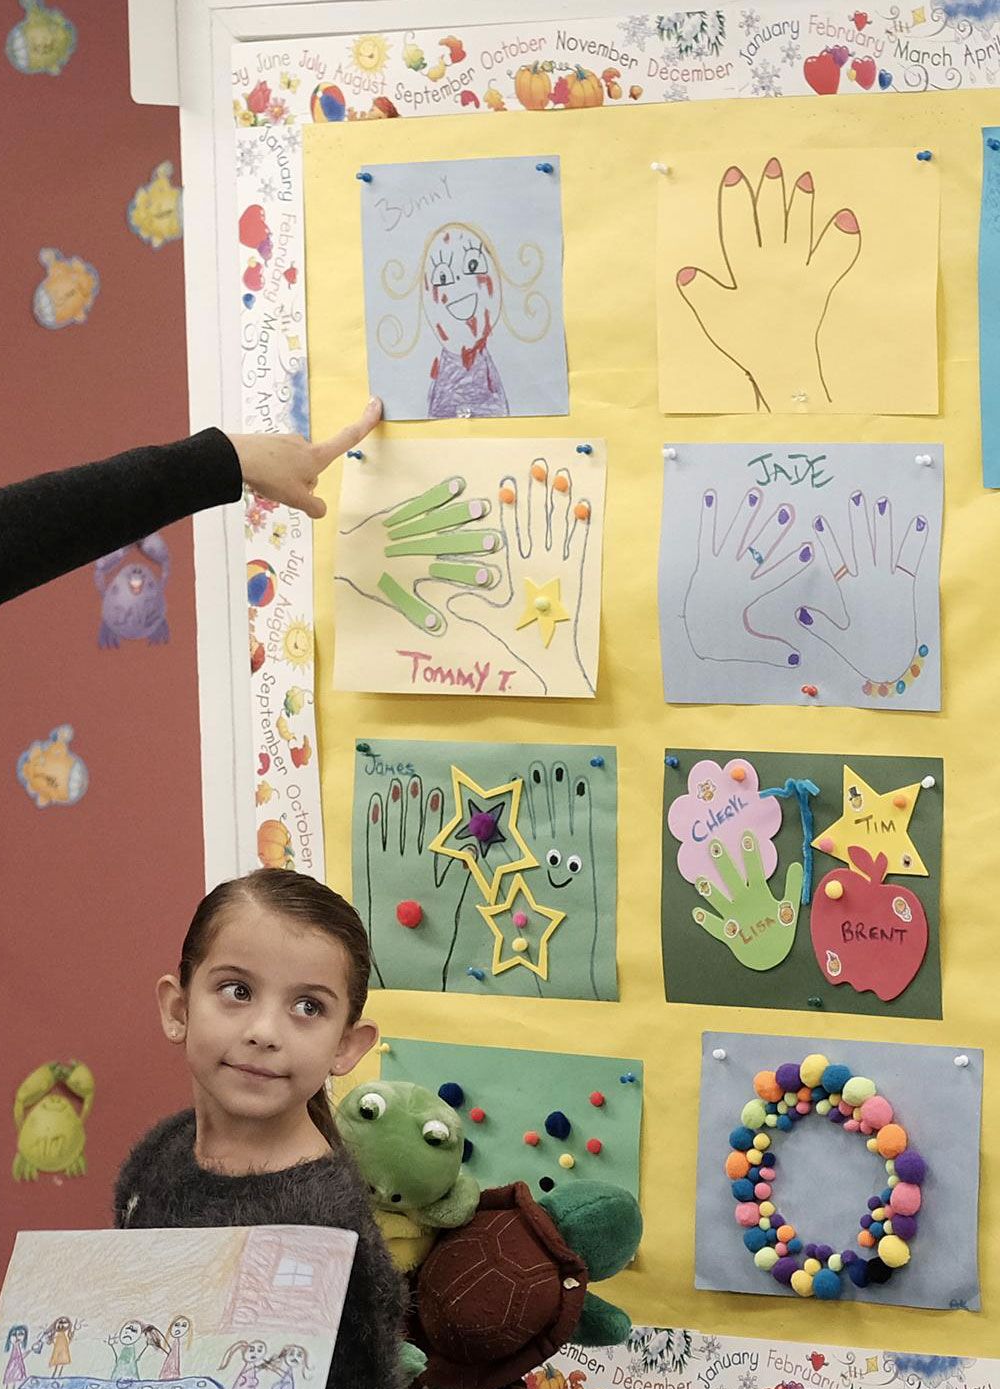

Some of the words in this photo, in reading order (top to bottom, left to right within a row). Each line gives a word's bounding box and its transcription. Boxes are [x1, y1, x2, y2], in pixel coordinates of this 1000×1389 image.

[739, 18, 800, 65] January
[808, 14, 885, 58] February
[895, 39, 953, 67] March
[231, 65, 249, 86] ay
[256, 52, 291, 73] June
[299, 49, 327, 80] July
[333, 65, 389, 95] August
[394, 67, 476, 110] September
[480, 36, 548, 71] October
[556, 30, 639, 70] November
[647, 58, 734, 82] December
[258, 125, 292, 202] January
[263, 212, 297, 304] February
[256, 313, 277, 378] March
[747, 452, 834, 488] JADE
[288, 508, 302, 540] une
[279, 549, 305, 586] July
[266, 594, 294, 665] August
[255, 671, 288, 776] September
[286, 784, 314, 869] October
[691, 795, 749, 843] CHERYL
[854, 814, 897, 834] TIM
[841, 920, 909, 944] BRENT
[697, 1349, 760, 1389] January
